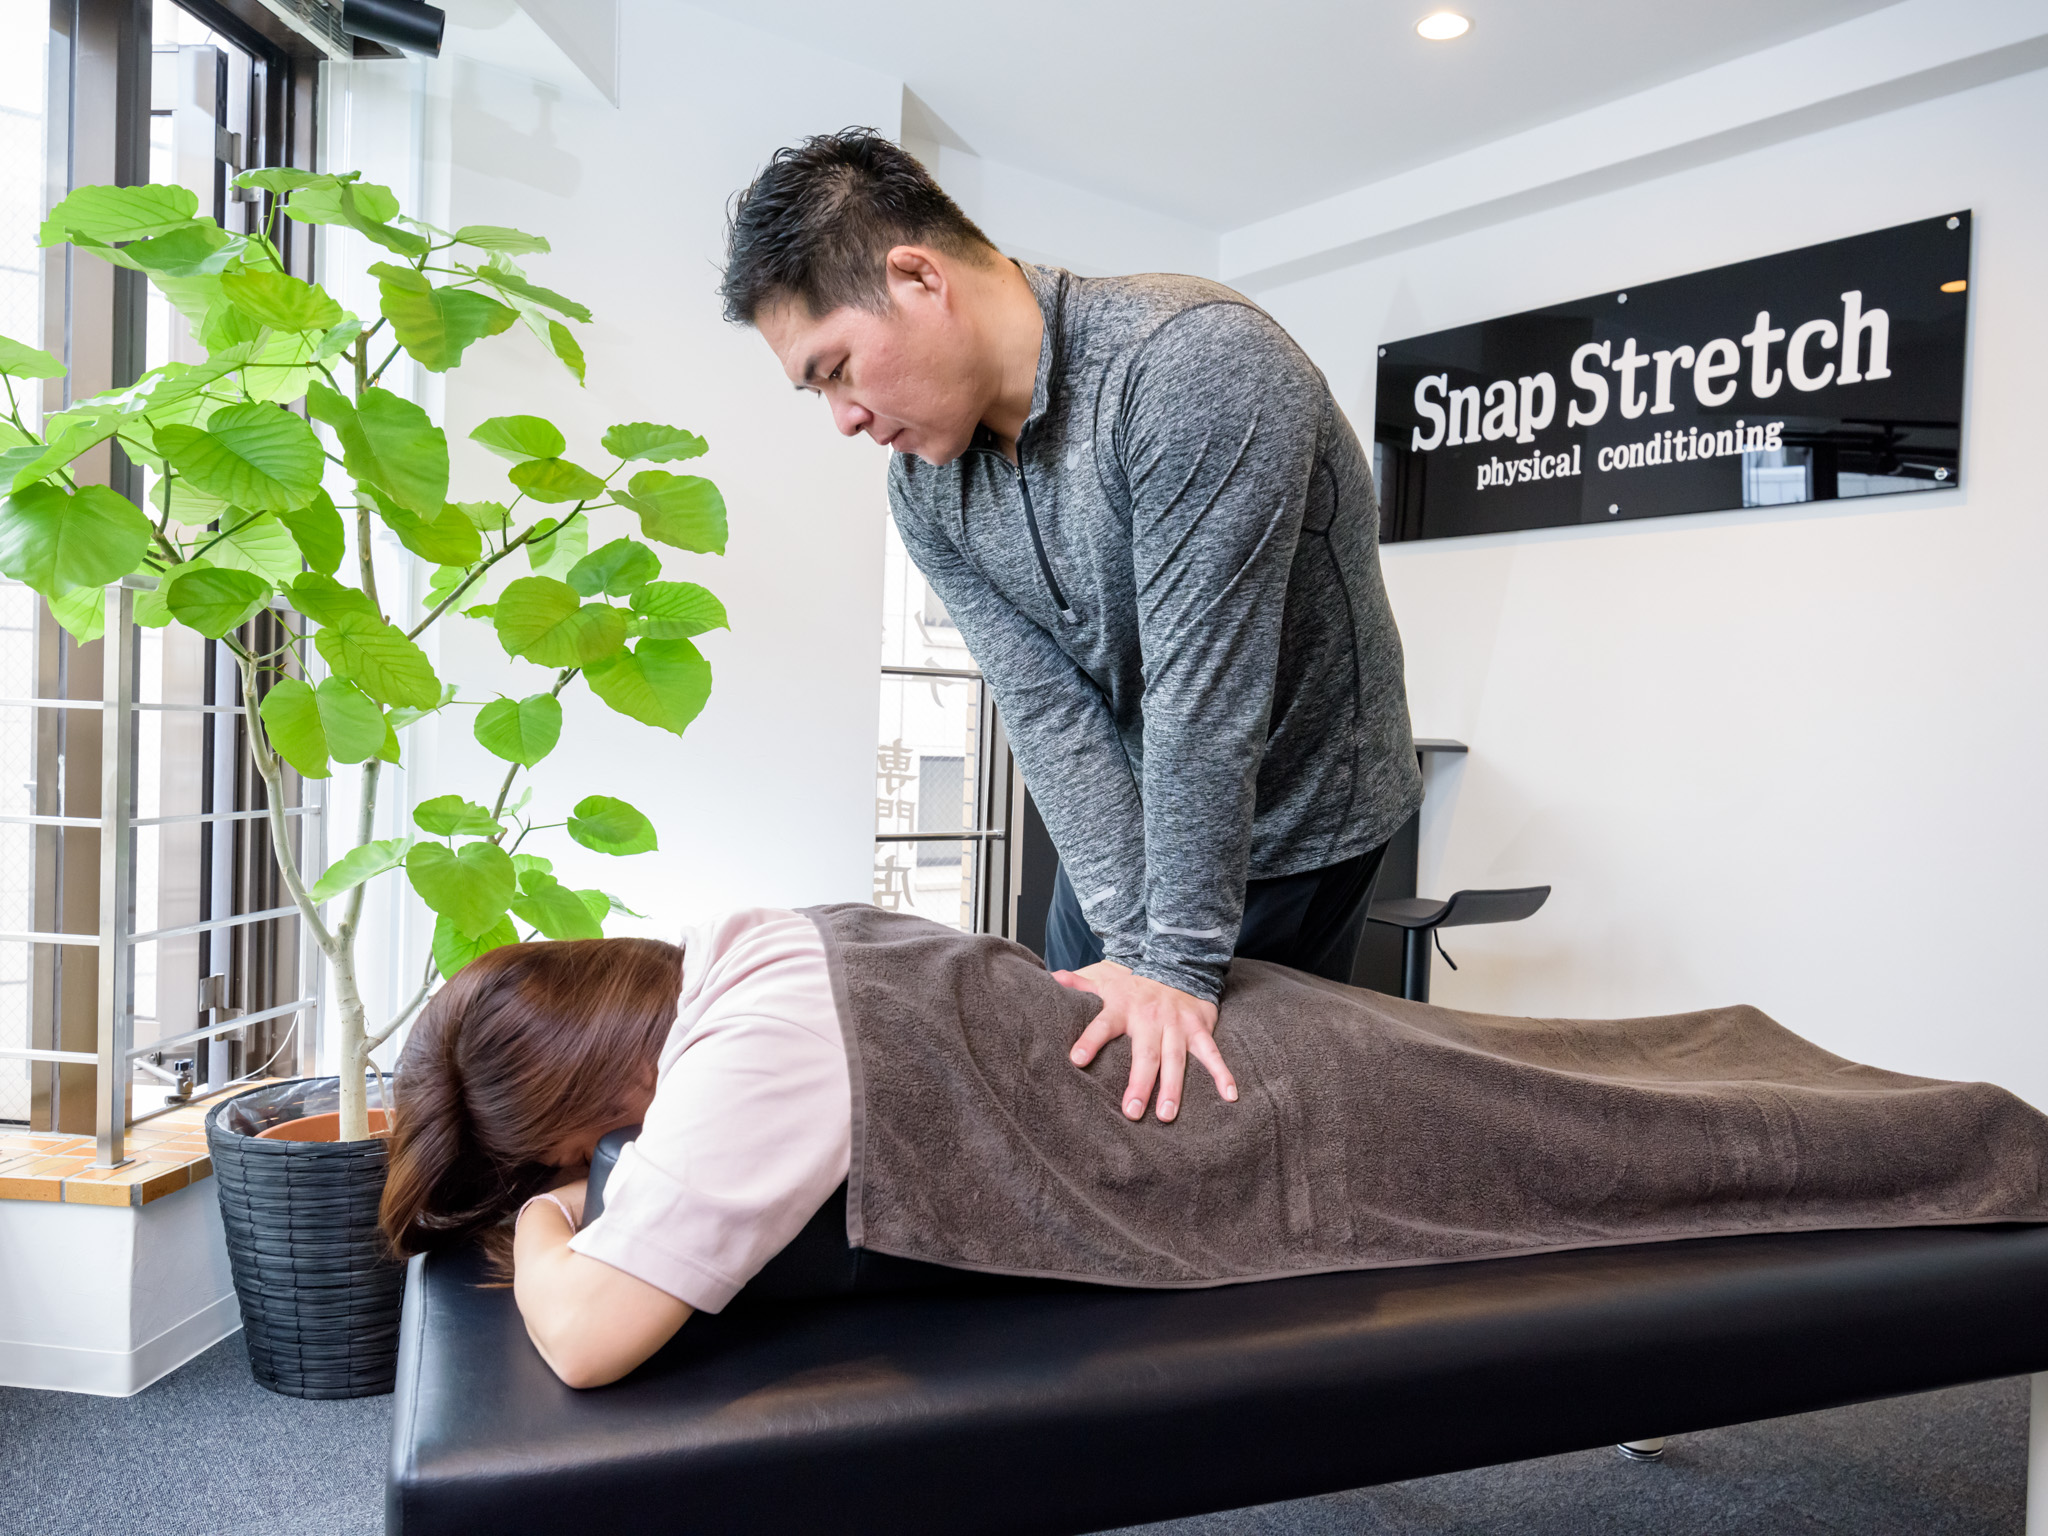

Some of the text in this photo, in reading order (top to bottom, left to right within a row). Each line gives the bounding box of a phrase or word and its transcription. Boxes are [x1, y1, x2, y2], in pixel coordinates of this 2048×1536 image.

[1411, 290, 1892, 452] Snap Stretch
[1476, 419, 1785, 491] physical conditioning
